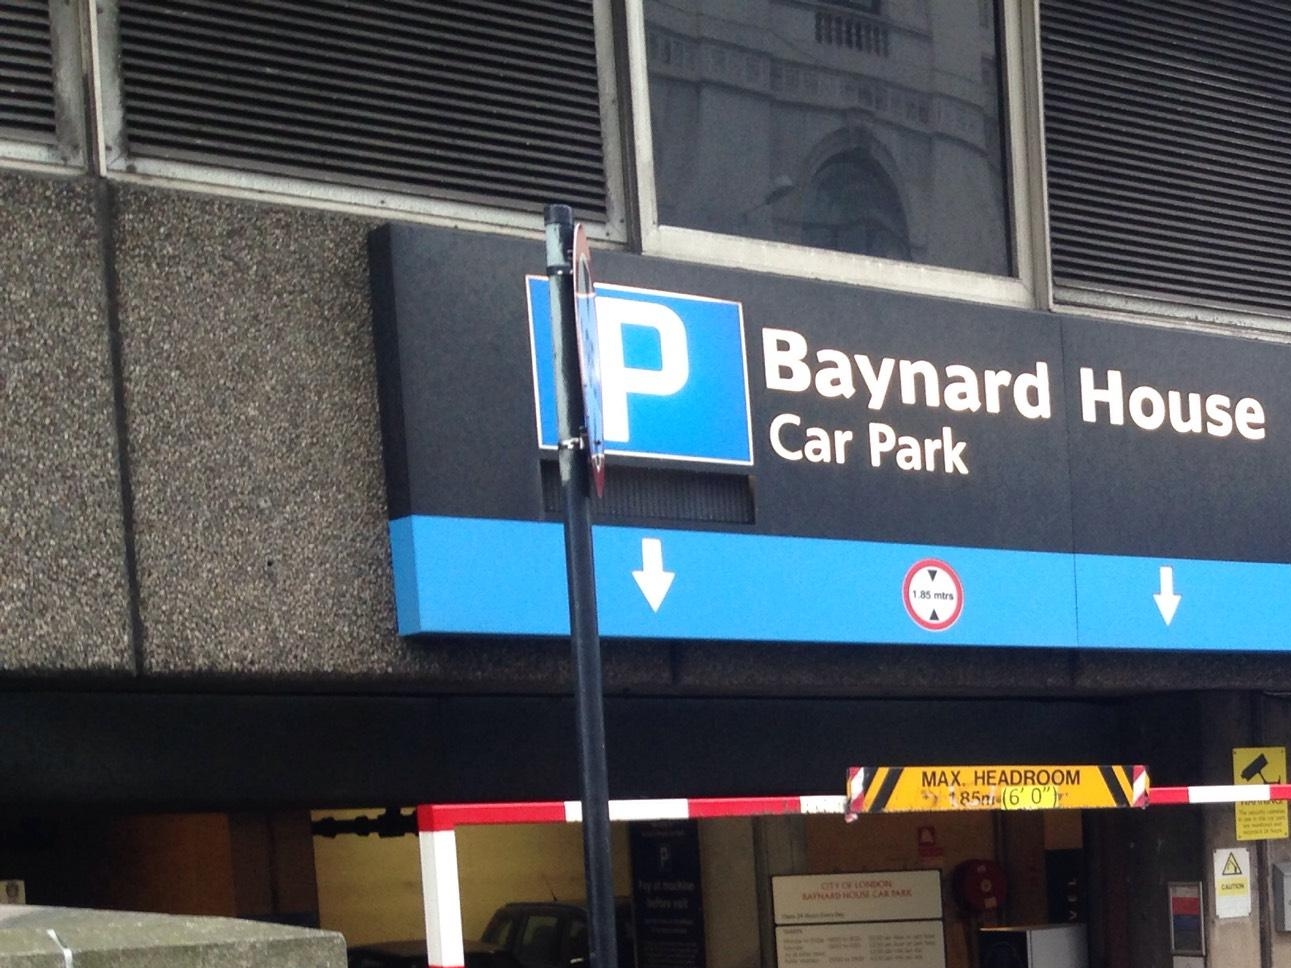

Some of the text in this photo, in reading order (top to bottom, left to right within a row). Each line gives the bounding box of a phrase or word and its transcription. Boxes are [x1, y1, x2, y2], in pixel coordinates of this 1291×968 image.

[595, 296, 690, 443] P
[760, 327, 1266, 440] Baynard House
[769, 412, 969, 475] Car Park
[913, 589, 954, 601] 1.85 mtrs
[922, 769, 1081, 787] MAX. HEADROOM
[891, 888, 913, 898] PARK
[1221, 882, 1245, 891] CAUTION
